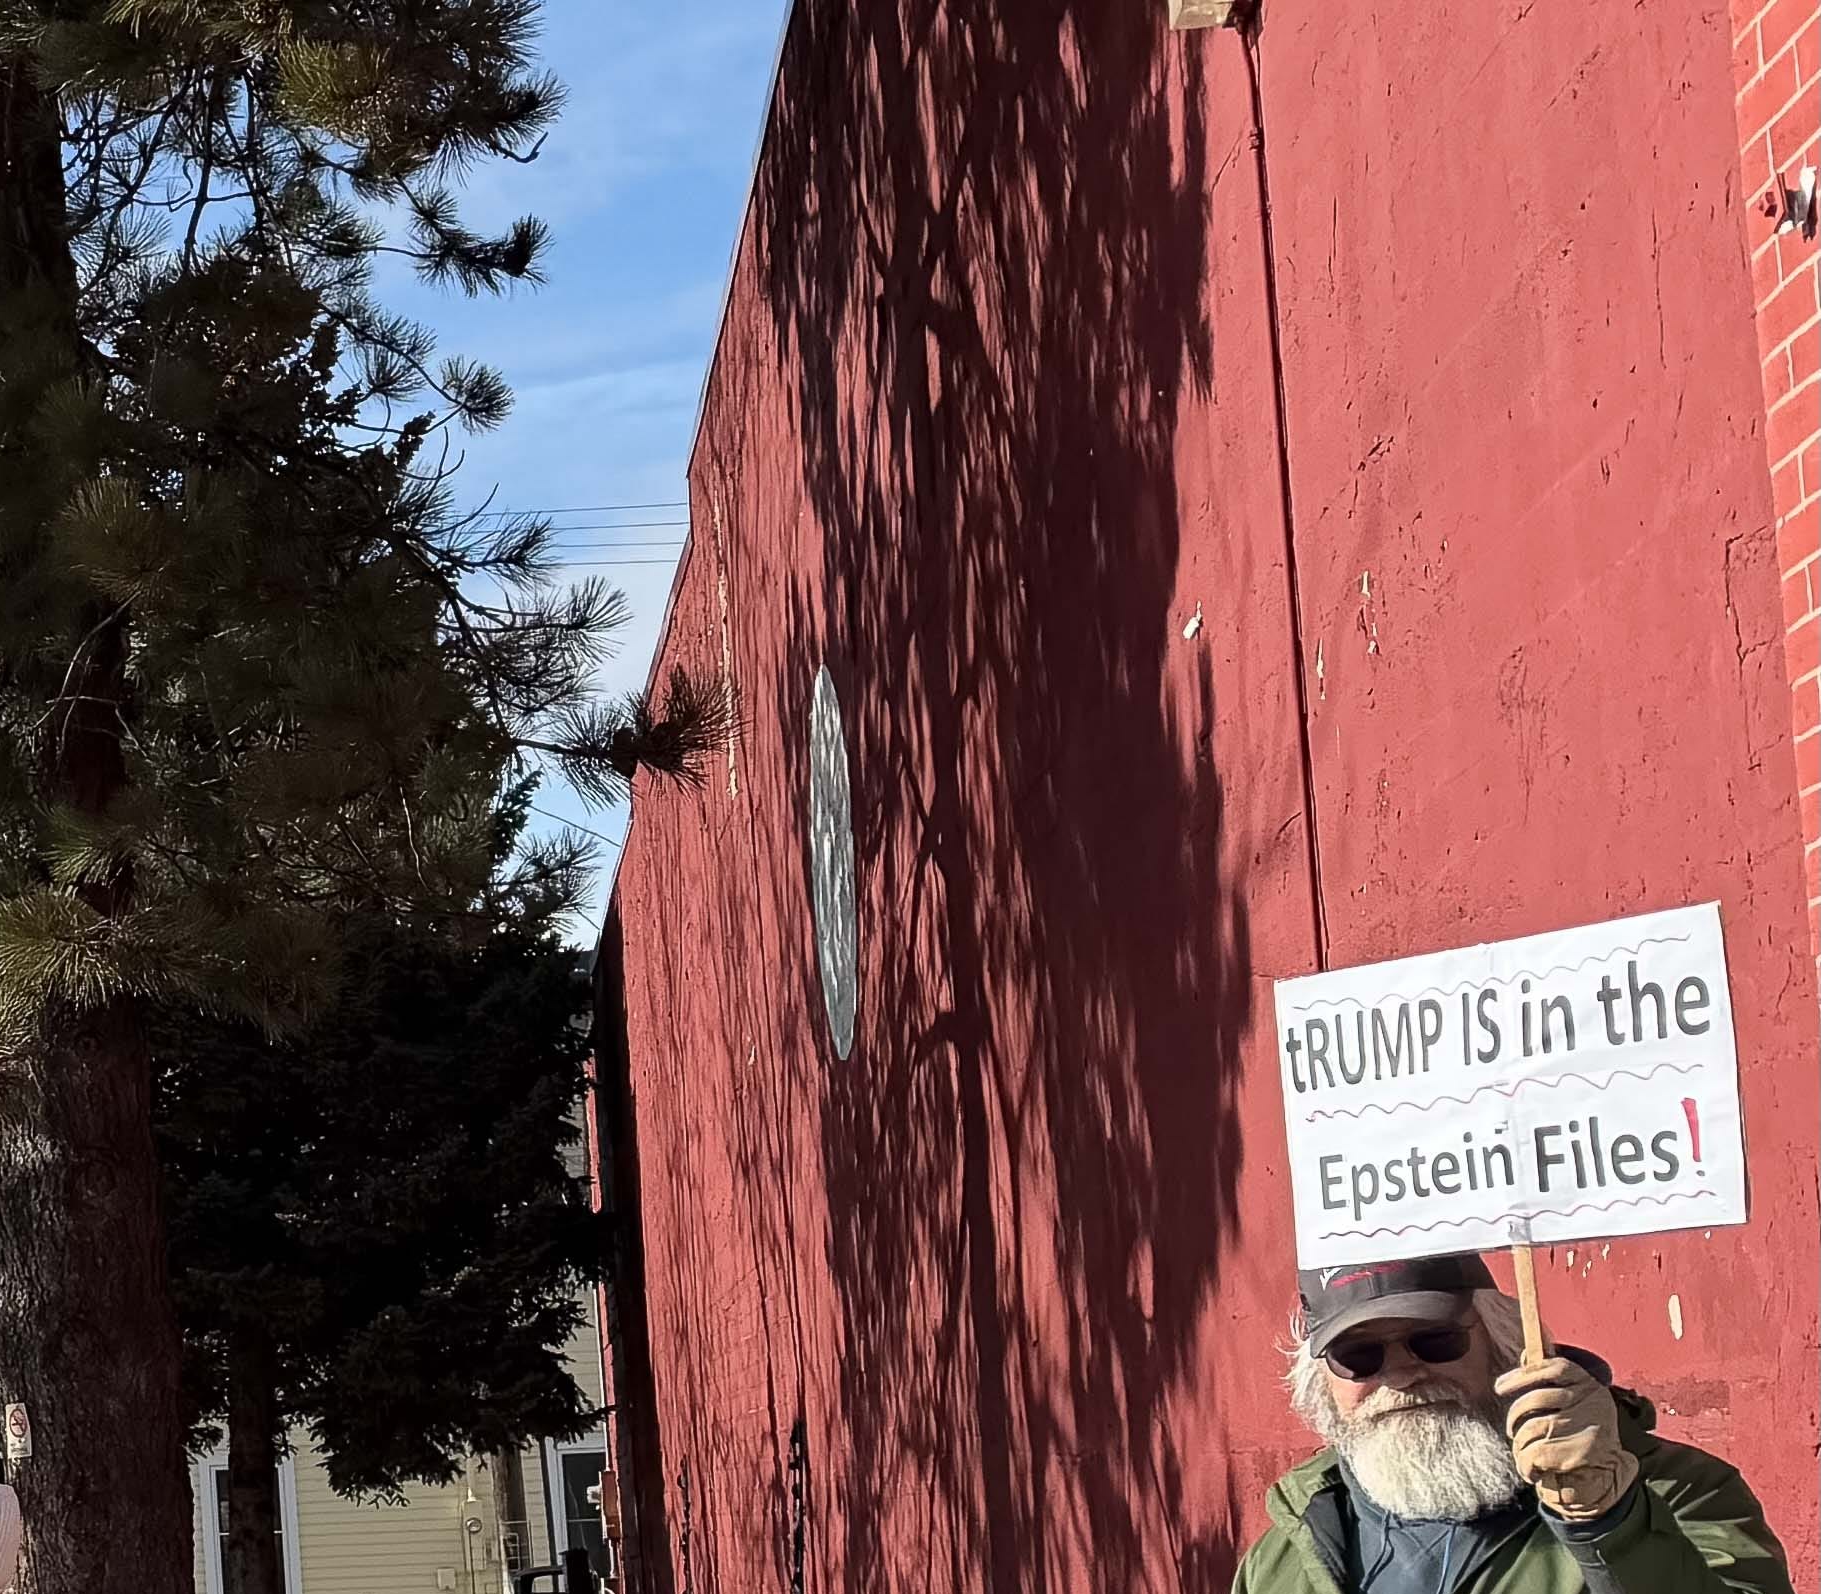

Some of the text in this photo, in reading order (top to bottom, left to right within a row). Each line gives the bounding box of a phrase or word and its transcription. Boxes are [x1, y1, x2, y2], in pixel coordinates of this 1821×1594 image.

[1286, 960, 1711, 1093] tRUMP IS in the
[1319, 1097, 1707, 1221] Epstein Files!
